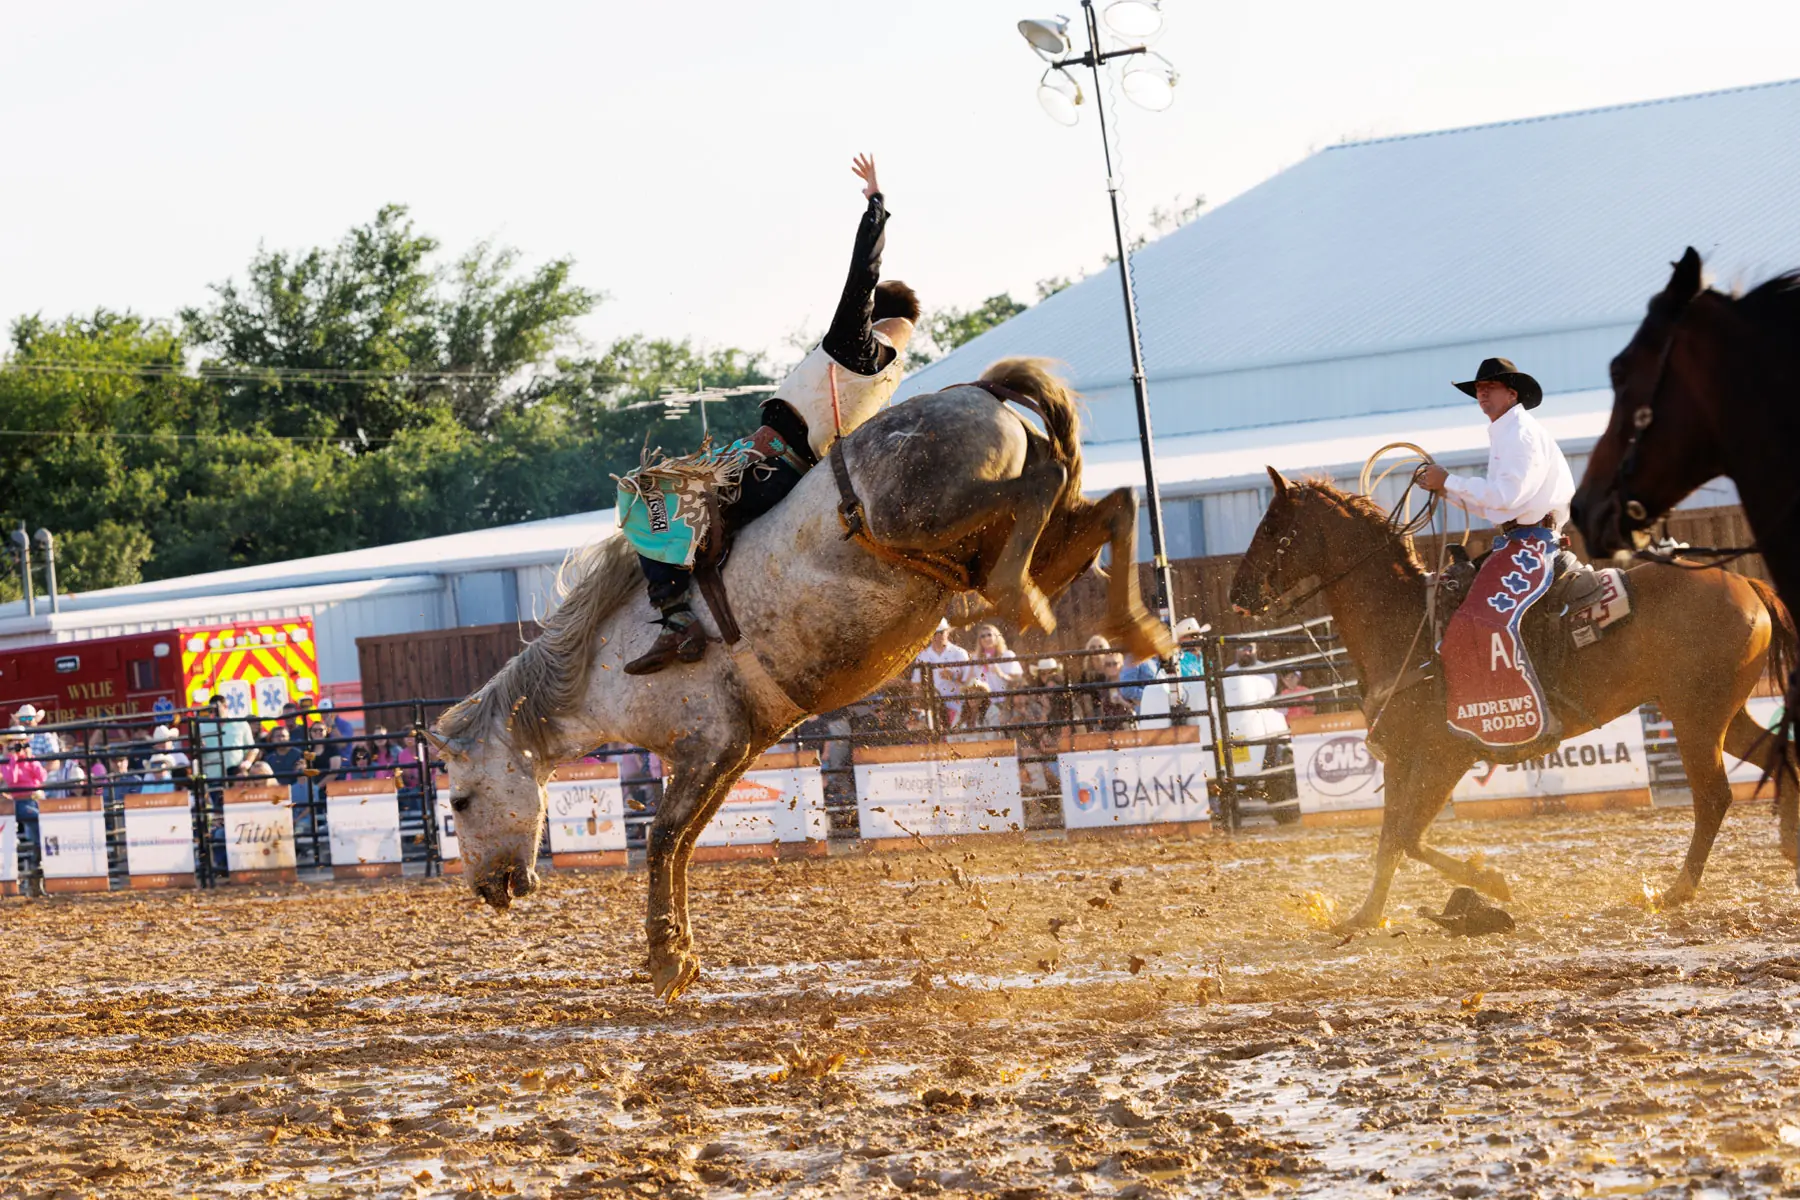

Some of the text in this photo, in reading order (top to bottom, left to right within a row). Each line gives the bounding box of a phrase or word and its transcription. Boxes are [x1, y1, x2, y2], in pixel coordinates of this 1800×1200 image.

[1491, 632, 1512, 671] A
[67, 680, 114, 699] WYLIE
[1457, 695, 1533, 719] ANDREWS
[1482, 711, 1537, 733] RODEO
[1317, 741, 1370, 771] CMS
[234, 820, 284, 845] Tito's
